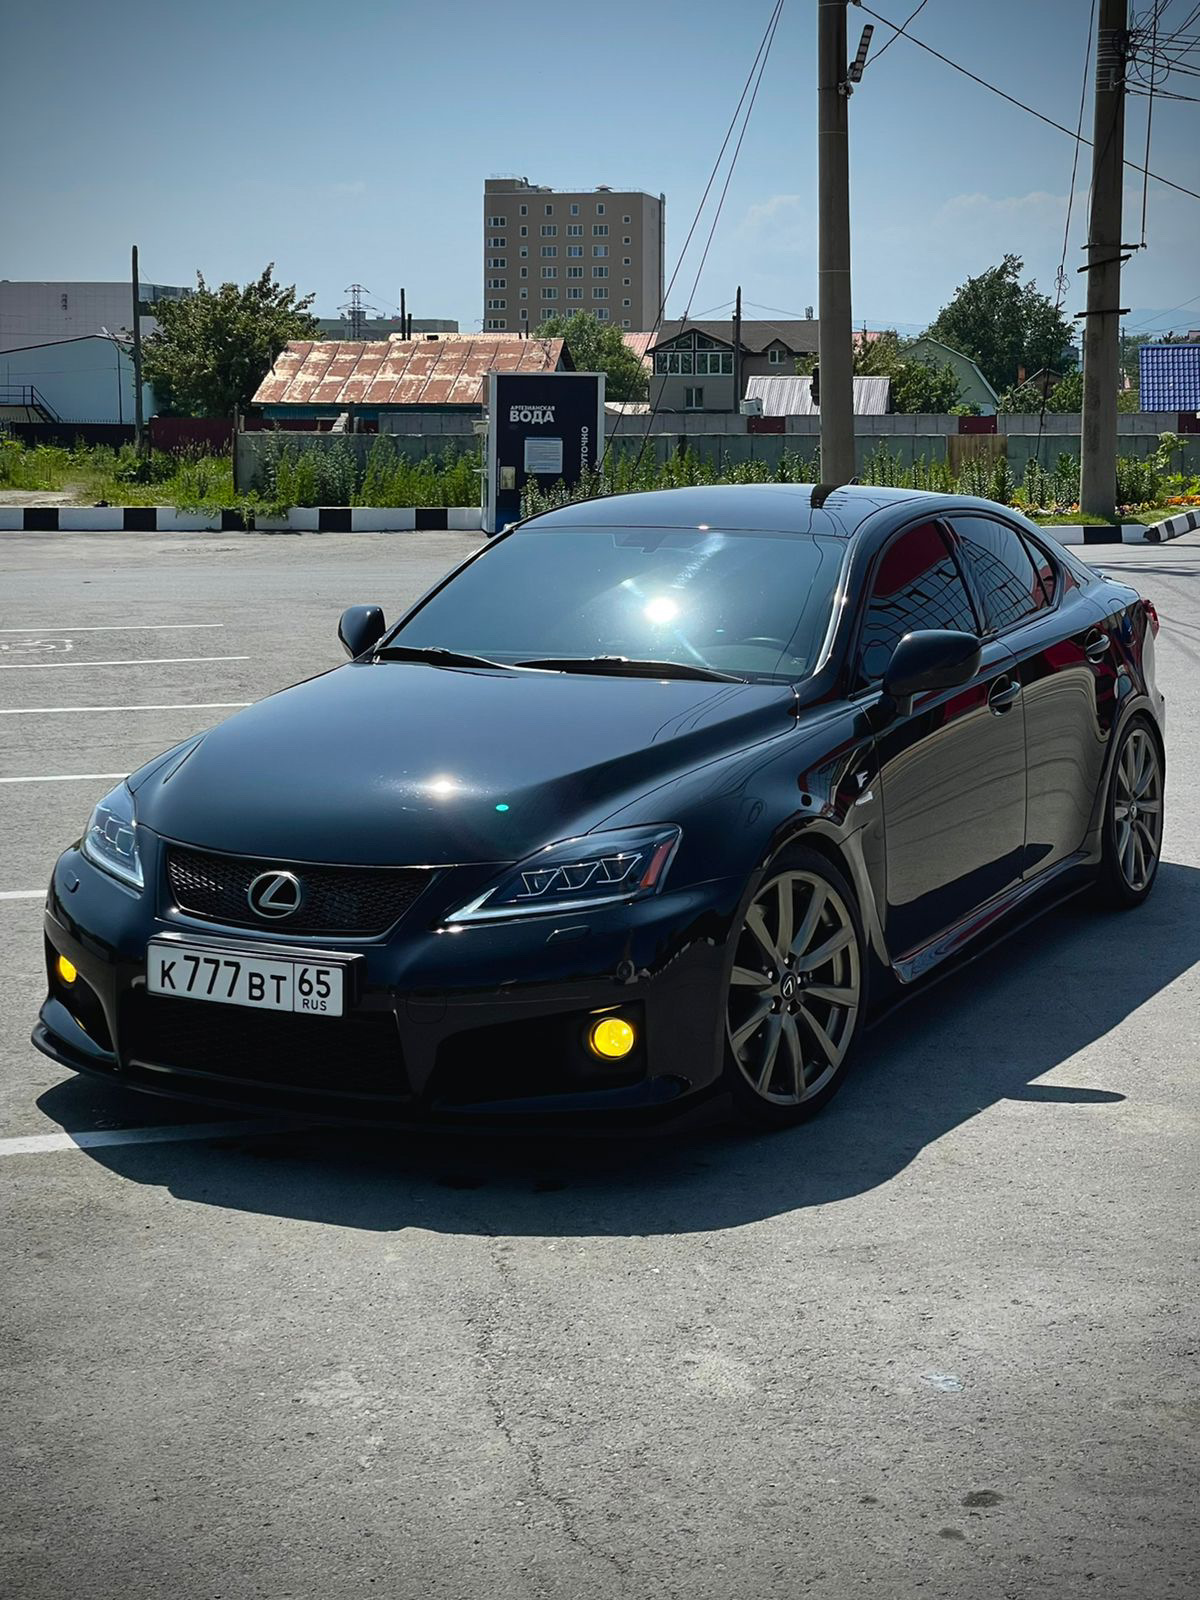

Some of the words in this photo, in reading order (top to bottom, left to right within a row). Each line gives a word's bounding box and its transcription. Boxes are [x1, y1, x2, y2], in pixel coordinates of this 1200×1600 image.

[509, 410, 555, 424] ВОДА
[298, 968, 331, 998] 65
[302, 998, 327, 1011] RUS
